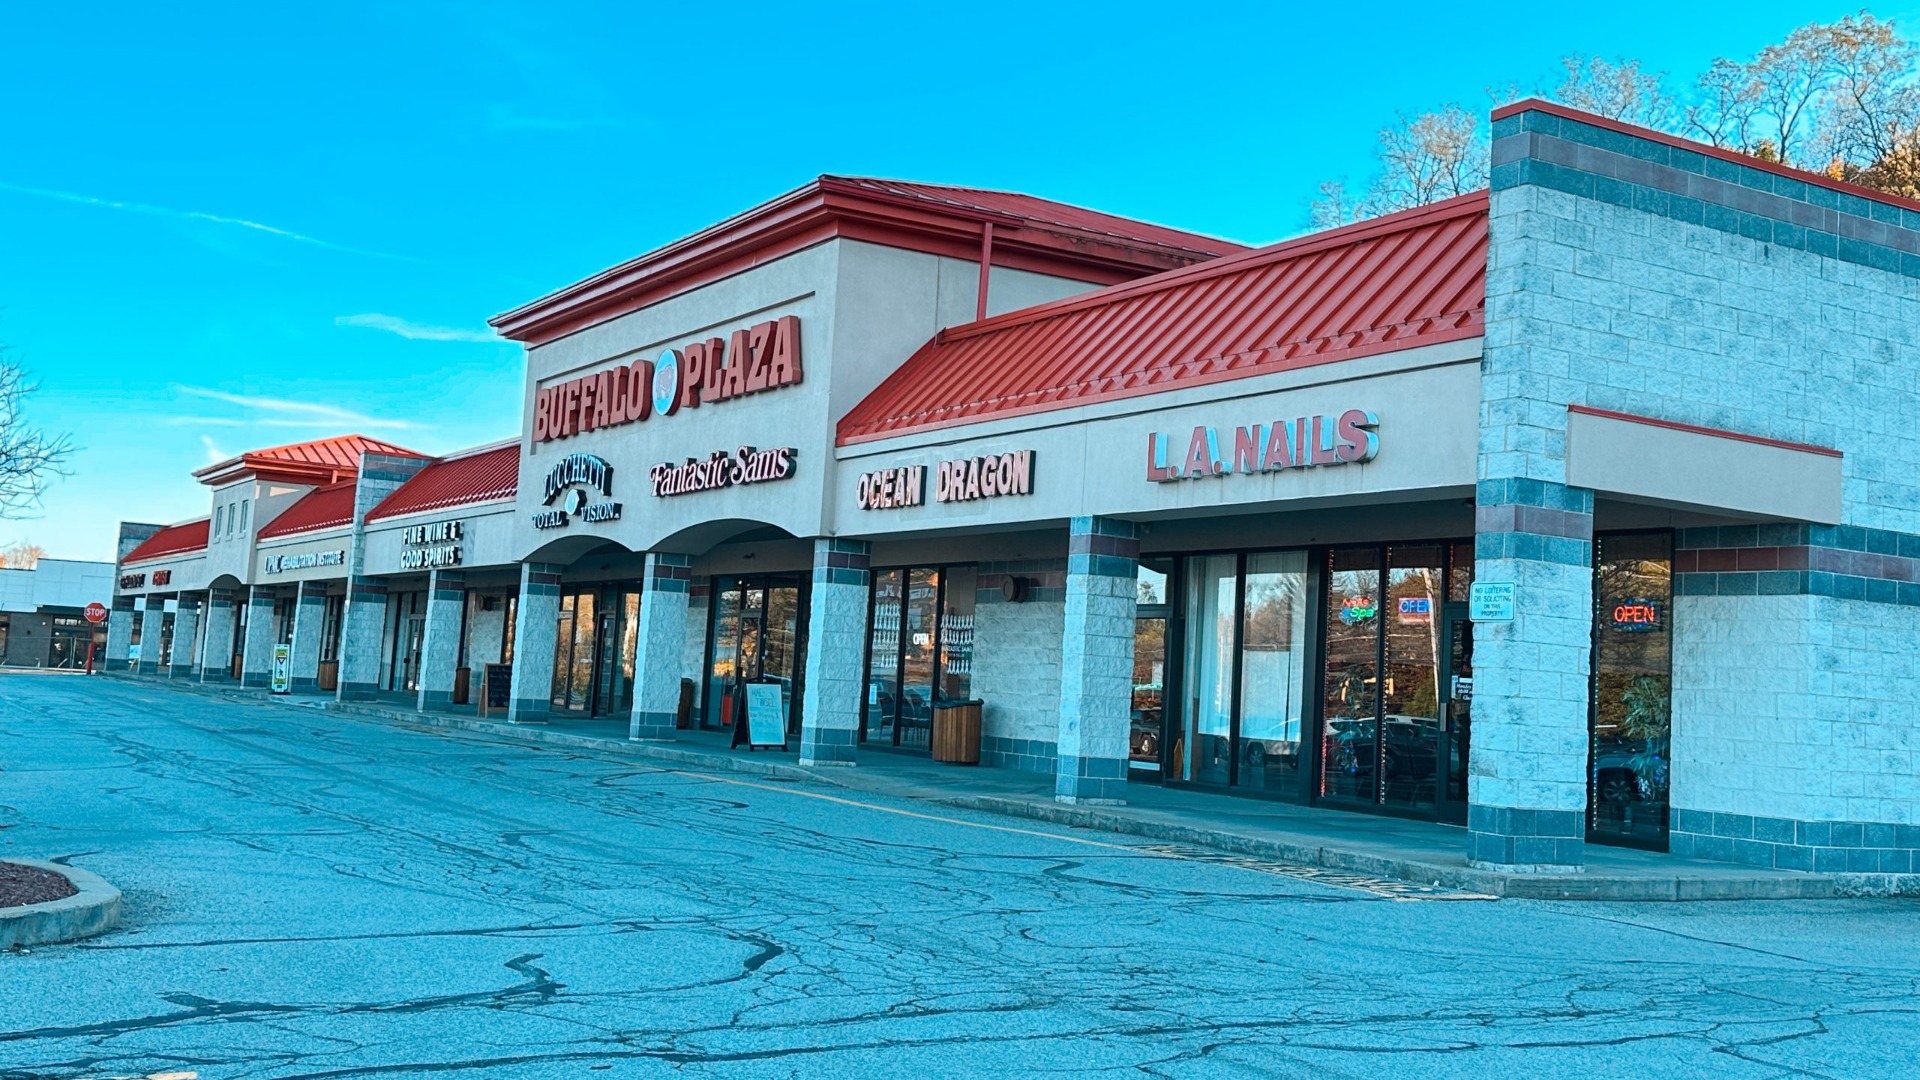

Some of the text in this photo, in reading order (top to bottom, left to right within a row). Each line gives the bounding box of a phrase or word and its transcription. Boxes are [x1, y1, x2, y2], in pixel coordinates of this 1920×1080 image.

[533, 315, 803, 442] BUFFALO PLAZA
[1147, 409, 1380, 483] L.A. NAILS
[650, 446, 798, 498] Fantastic Sams
[856, 449, 1036, 510] OCEAN DRAGON
[532, 503, 621, 530] TOTAL VISION
[403, 526, 424, 545] FINE
[425, 522, 450, 543] WINE
[401, 545, 459, 569] GOOD SPIRITS
[86, 607, 105, 617] STOP
[1350, 606, 1376, 620] Spa
[1614, 605, 1655, 623] OPEN
[912, 632, 930, 646] OPEN
